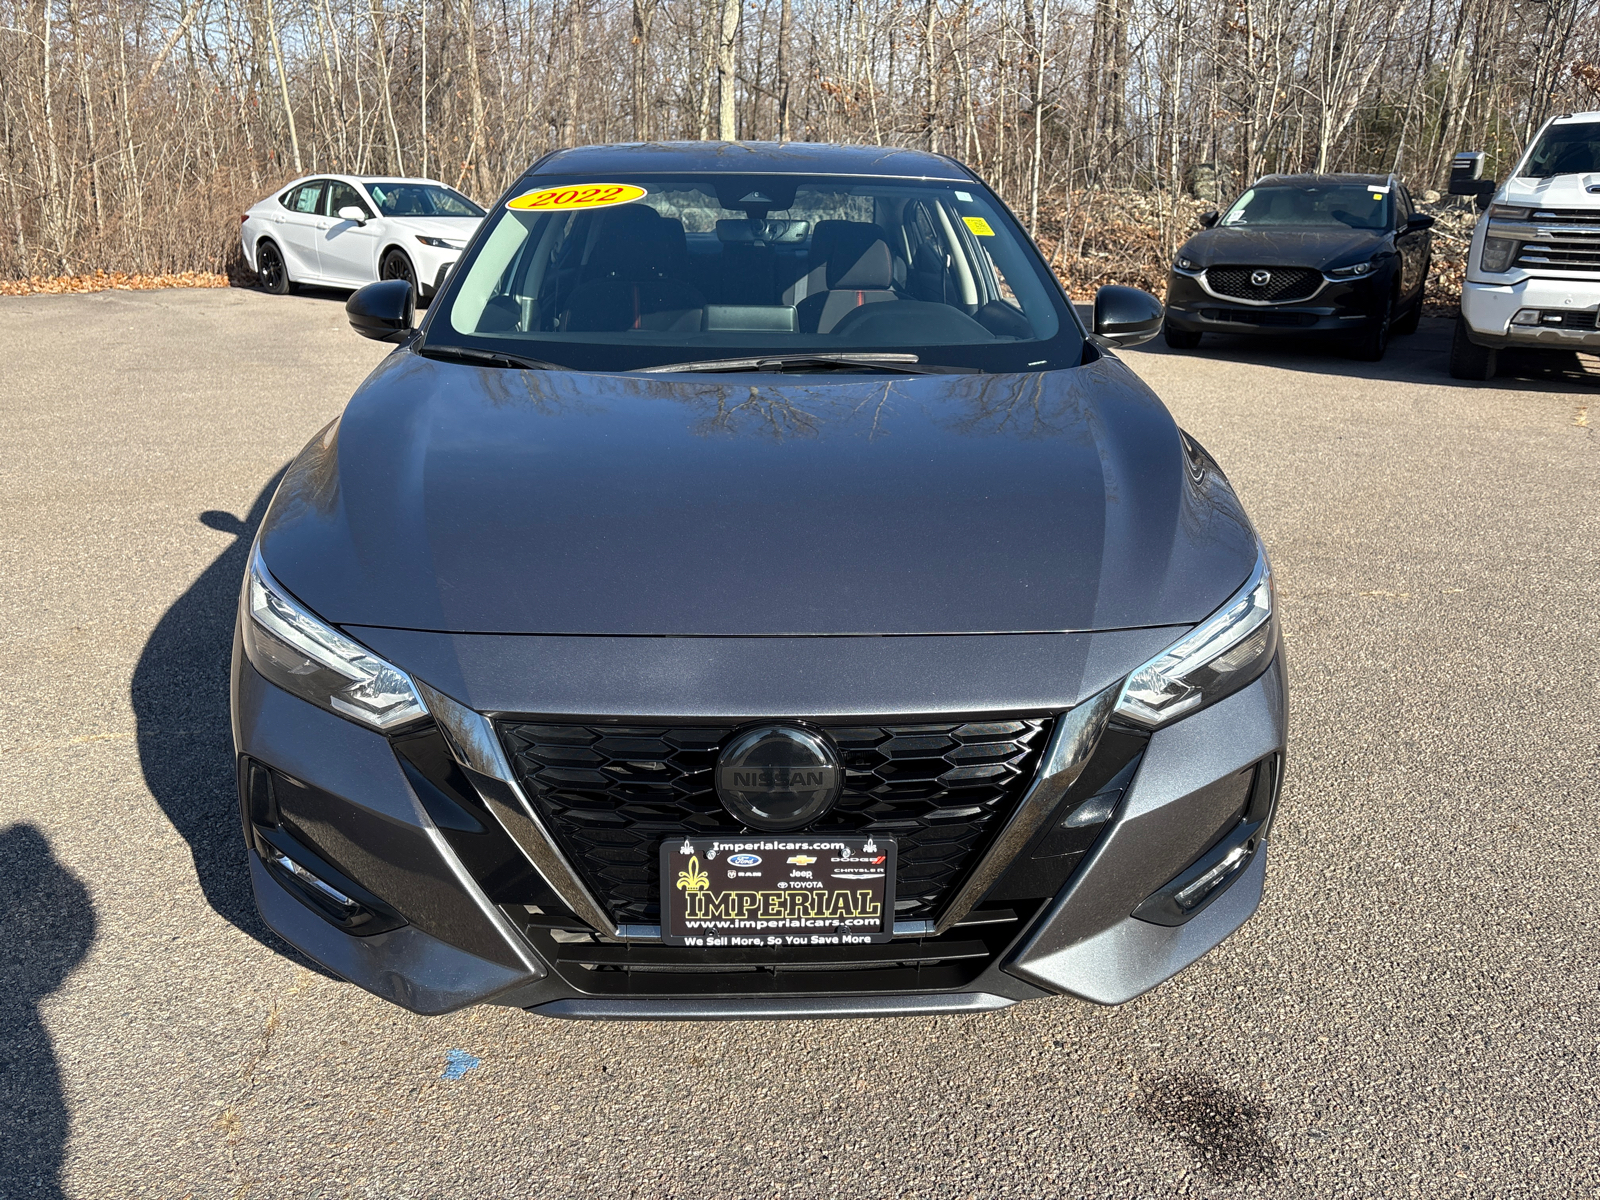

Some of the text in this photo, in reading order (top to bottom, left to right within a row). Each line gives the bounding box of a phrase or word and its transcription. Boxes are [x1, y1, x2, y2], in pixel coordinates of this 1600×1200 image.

[528, 187, 624, 207] 2022
[733, 770, 824, 787] NISSAN
[713, 841, 845, 853] Imperialcars.com
[734, 855, 755, 865] Ford
[789, 869, 812, 879] Jeep
[685, 890, 881, 919] IMPERIAL
[685, 918, 880, 930] www.imperialcars.com
[684, 934, 872, 947] We Sell More, So You Save More
